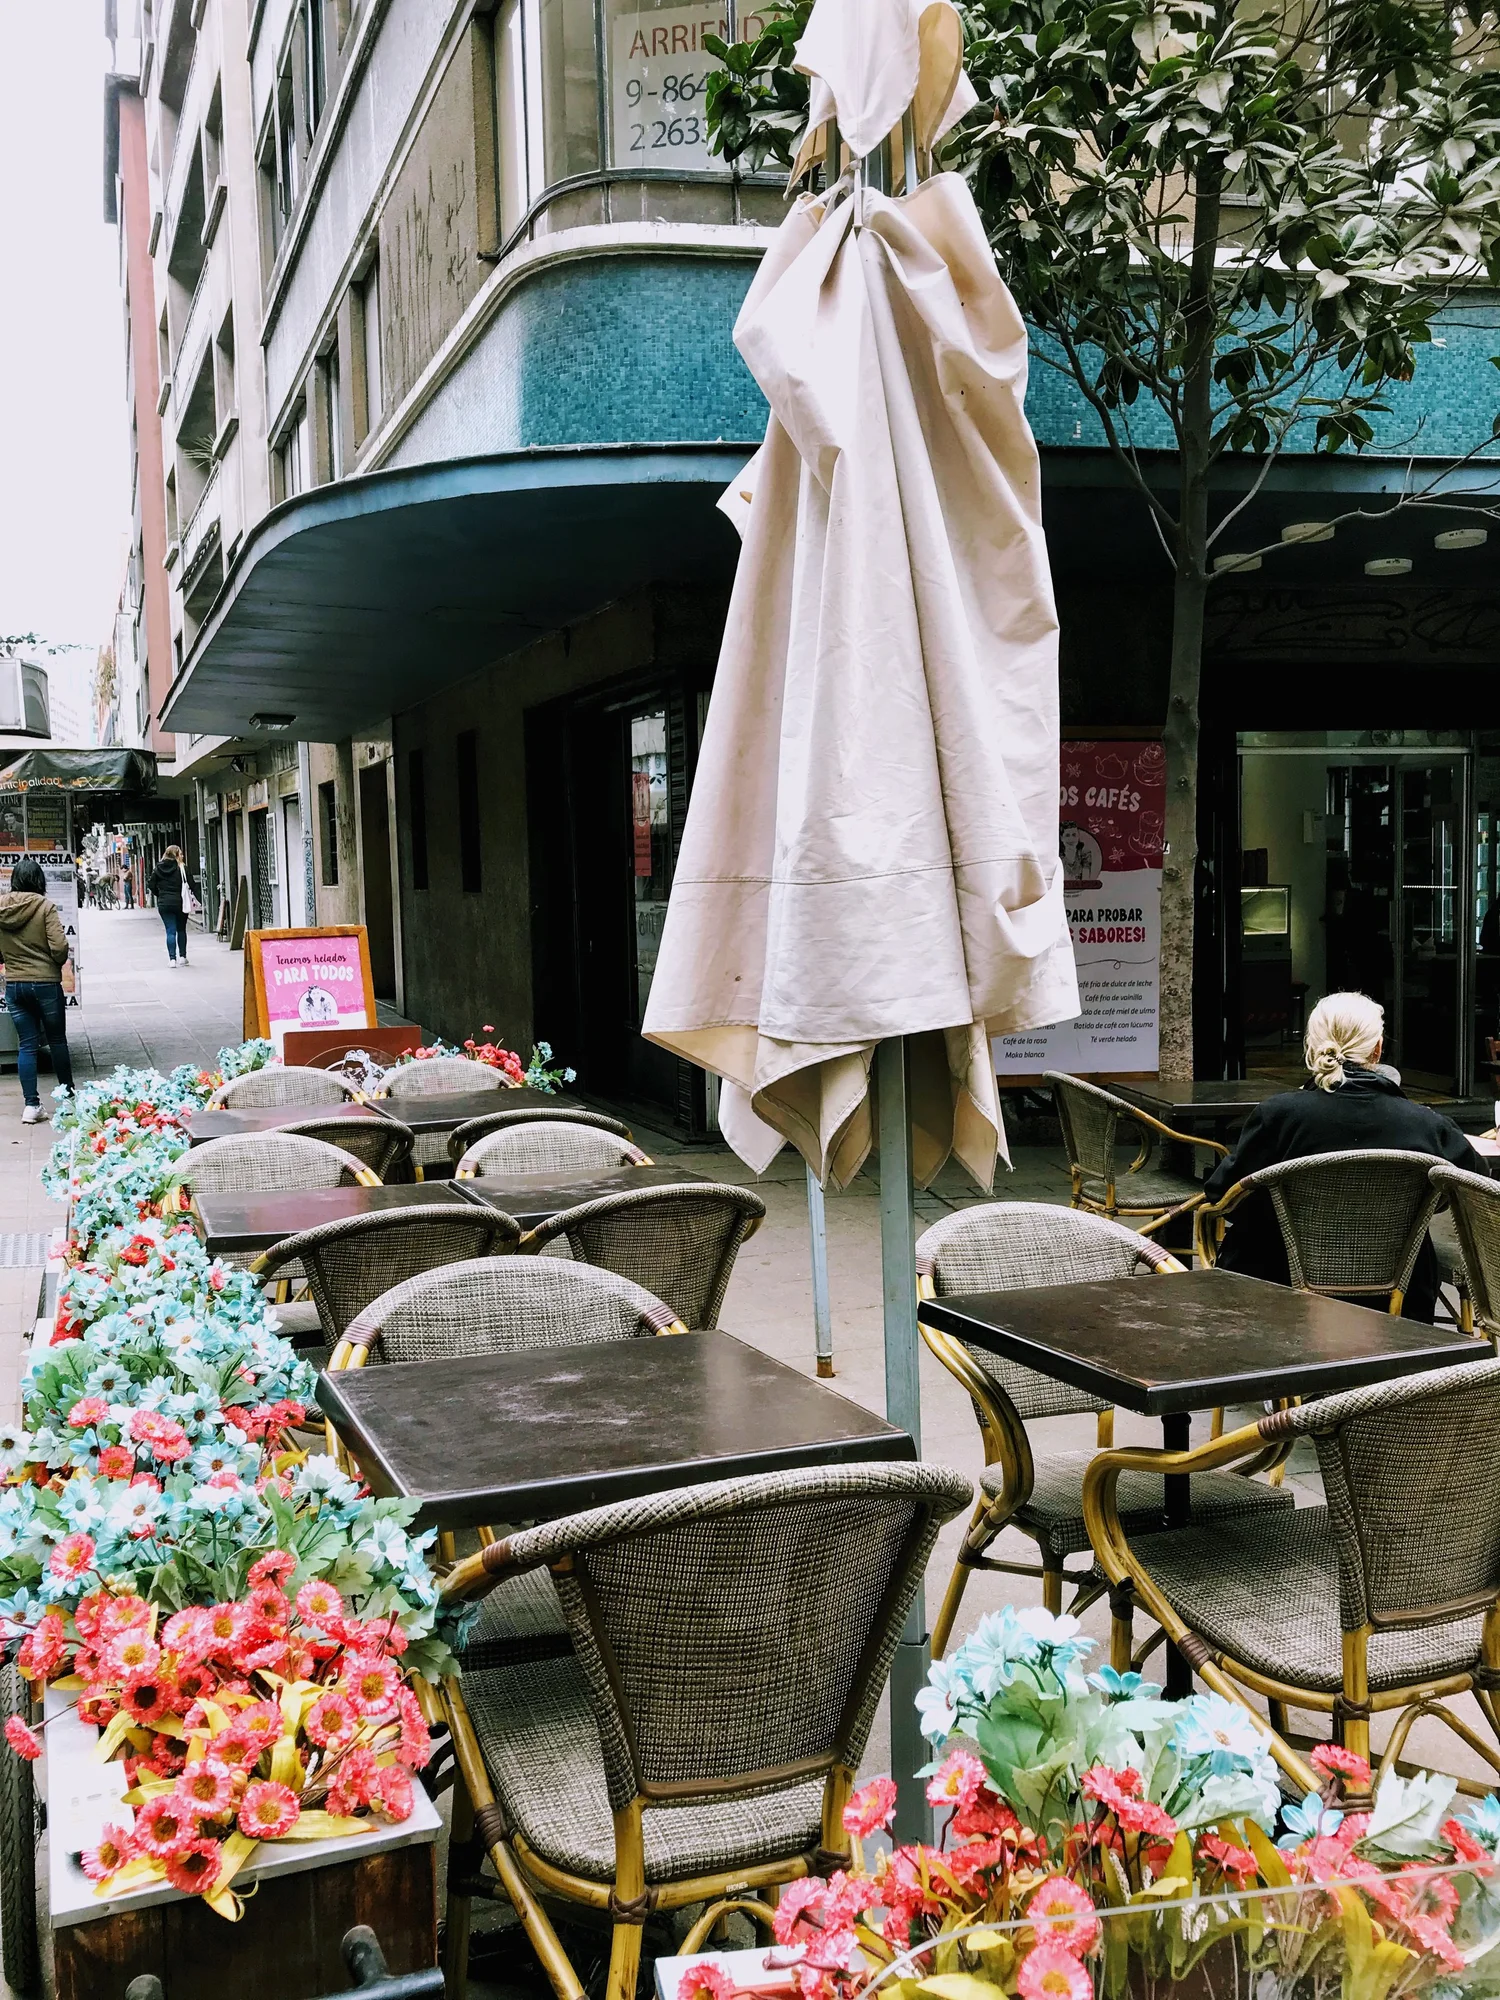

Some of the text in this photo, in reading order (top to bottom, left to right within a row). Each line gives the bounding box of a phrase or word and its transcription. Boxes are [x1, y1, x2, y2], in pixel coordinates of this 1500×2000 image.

[1085, 784, 1142, 812] CAFÉS
[0, 853, 73, 865] TRATEGIA
[1066, 908, 1143, 923] PARA PROBAR
[1079, 926, 1146, 943] SABORES!
[276, 953, 347, 965] Tenemos helados
[273, 964, 354, 986] PARA TODOS
[1102, 980, 1110, 988] de
[1136, 979, 1153, 987] leche
[1085, 994, 1099, 1003] Café
[1120, 993, 1143, 1001] vainilla
[1102, 1008, 1115, 1016] café
[1116, 1007, 1130, 1015] miel
[1104, 1021, 1117, 1030] café
[1002, 1037, 1017, 1046] Café
[1091, 1035, 1097, 1043] Té
[1098, 1035, 1115, 1043] verde
